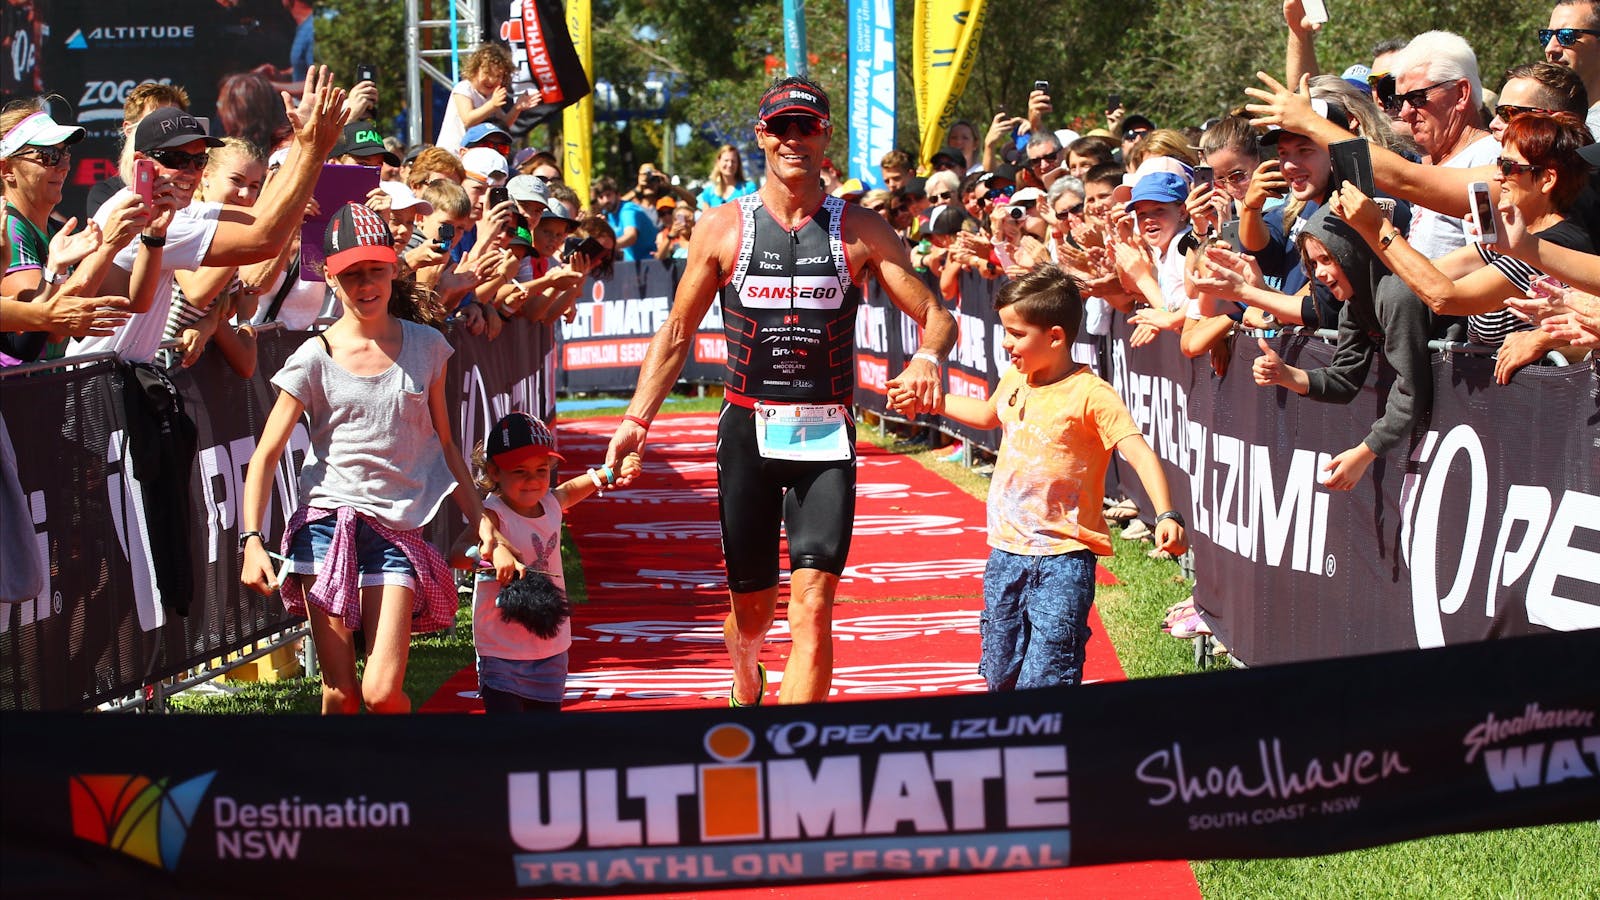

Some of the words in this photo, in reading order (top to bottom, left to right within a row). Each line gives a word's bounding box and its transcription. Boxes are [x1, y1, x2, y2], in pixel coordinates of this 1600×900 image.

[88, 26, 195, 39] ALTITUDE
[78, 78, 172, 106] ZOG
[759, 261, 783, 271] Tacx
[763, 251, 781, 261] TYR
[795, 256, 829, 265] 2XU
[747, 286, 837, 299] SANSEGO
[796, 426, 807, 448] 1
[819, 722, 943, 746] PEARL
[1136, 738, 1412, 806] Shoalhaven
[214, 796, 410, 829] Destination
[1188, 810, 1249, 831] SOUTH
[1252, 803, 1307, 825] COAST
[1321, 796, 1361, 815] NSW
[217, 831, 302, 860] NSW
[522, 853, 804, 884] TRIATHLON
[824, 843, 1064, 874] FESTIVAL
